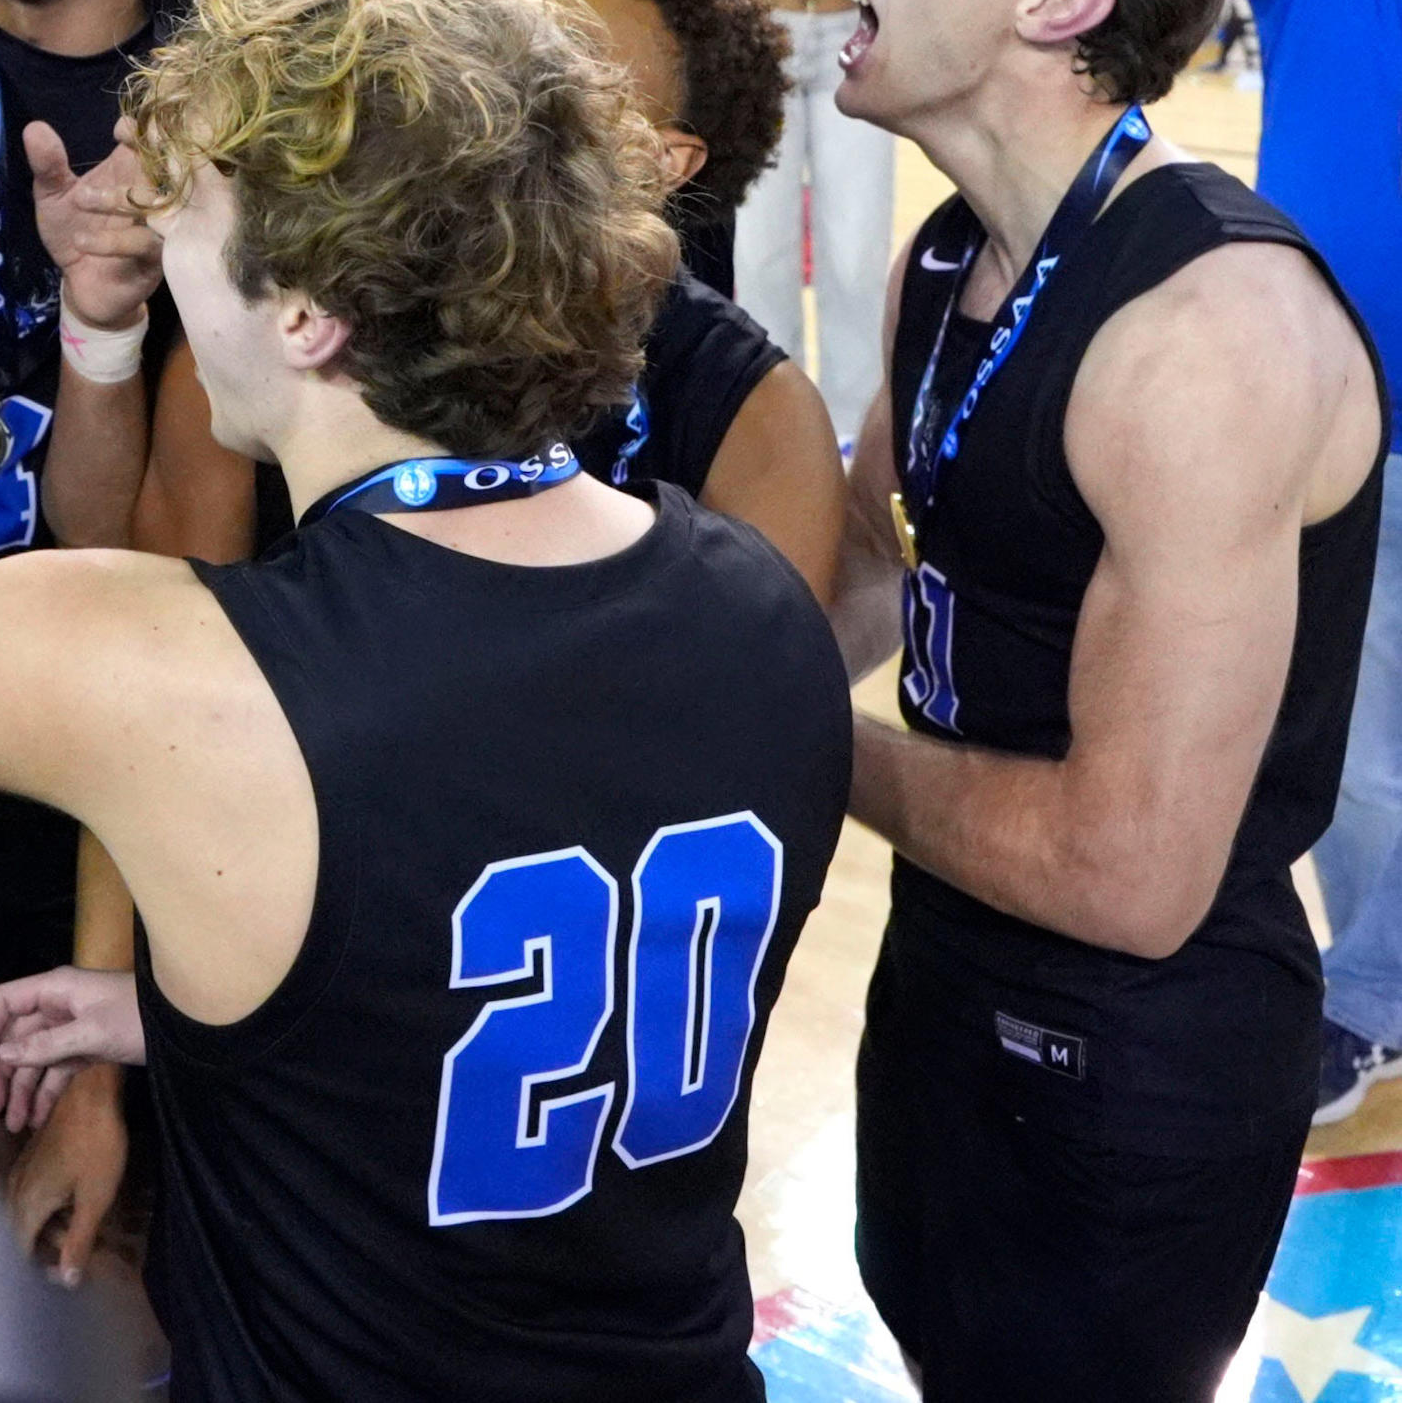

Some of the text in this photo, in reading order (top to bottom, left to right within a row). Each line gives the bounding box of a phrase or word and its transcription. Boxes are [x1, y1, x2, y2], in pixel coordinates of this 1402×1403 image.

[962, 255, 1060, 419] OSSAA
[463, 442, 576, 490] OSS
[429, 810, 783, 1227] 20
[1051, 1044, 1069, 1067] M
